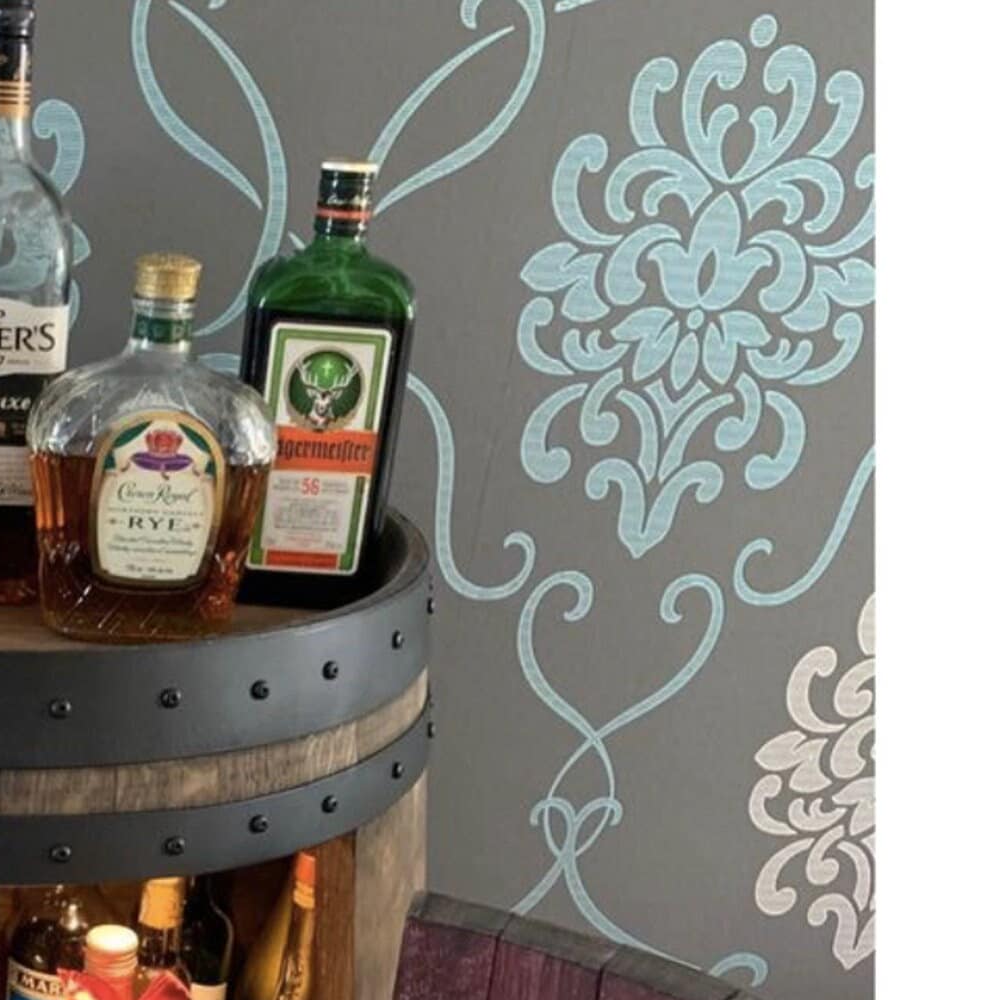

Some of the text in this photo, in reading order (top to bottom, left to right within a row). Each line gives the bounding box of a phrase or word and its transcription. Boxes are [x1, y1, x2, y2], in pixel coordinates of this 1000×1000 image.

[278, 439, 369, 464] germeister
[302, 477, 320, 496] 56
[127, 516, 191, 531] RYE
